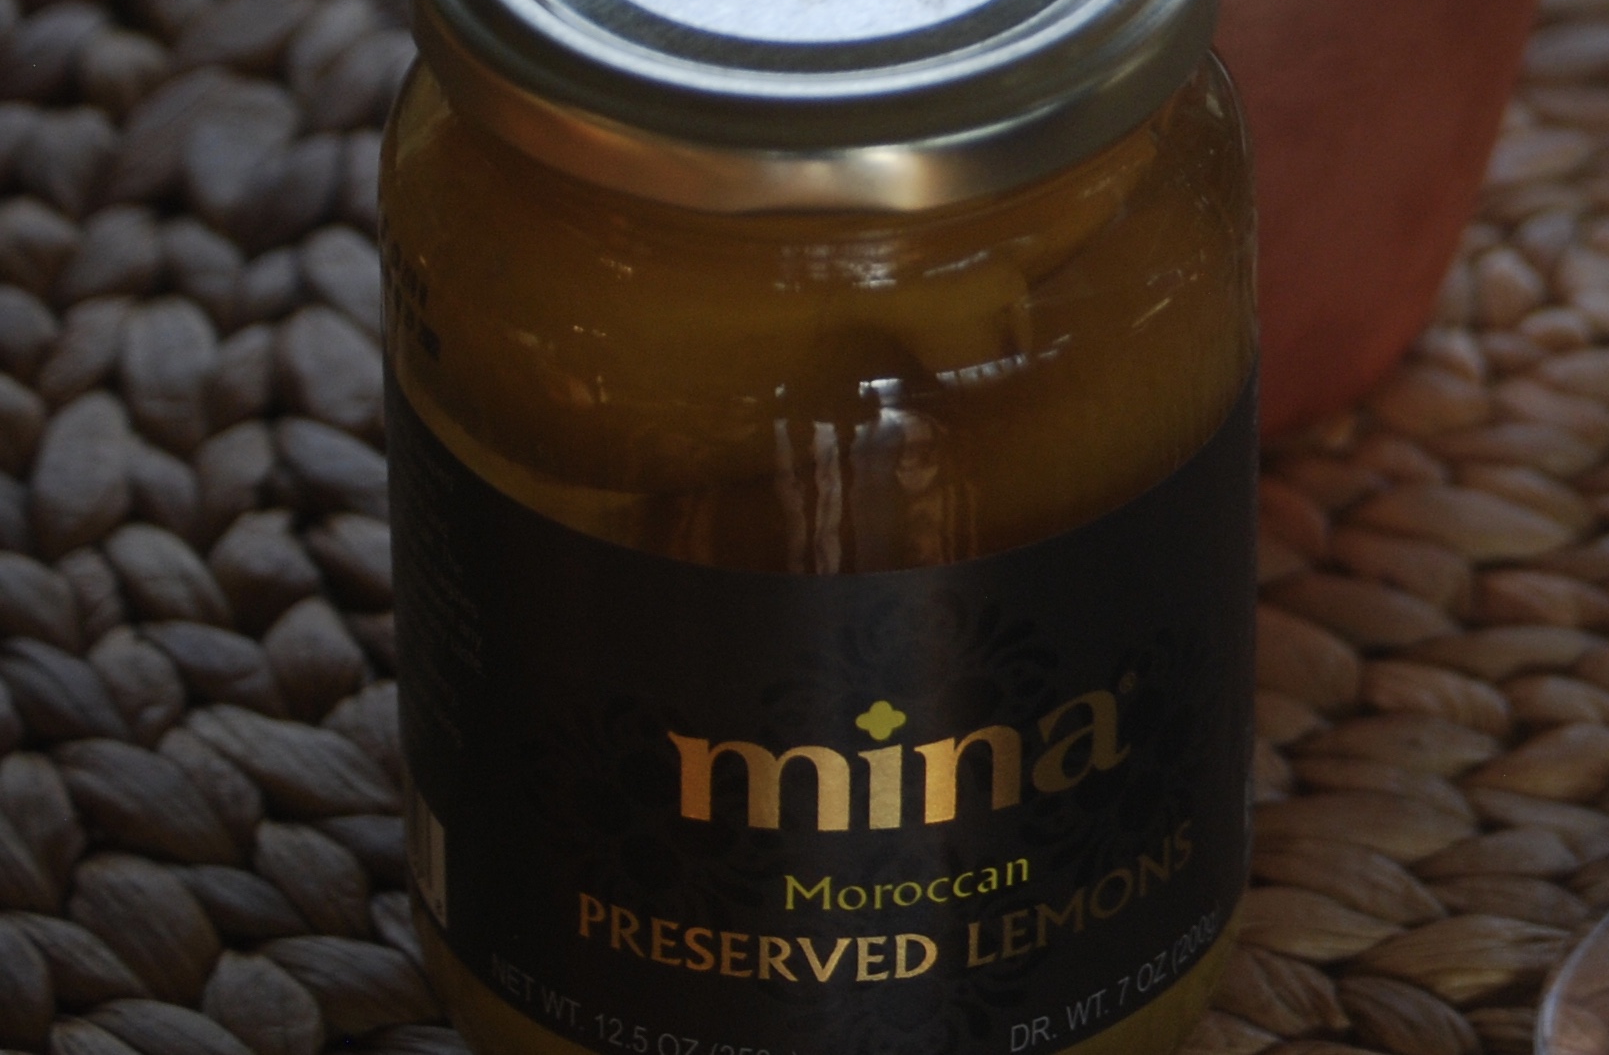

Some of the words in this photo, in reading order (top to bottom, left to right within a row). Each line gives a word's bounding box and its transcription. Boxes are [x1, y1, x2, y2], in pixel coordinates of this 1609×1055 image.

[577, 891, 938, 983] PRESERVED
[966, 818, 1194, 968] LEMONS
[783, 856, 1031, 911] Moroccan
[491, 952, 535, 1002] NET
[541, 986, 586, 1032] WT.
[594, 1012, 650, 1054] 12.5
[1010, 1015, 1058, 1053] DR.
[1065, 988, 1110, 1032] WT.
[1116, 975, 1131, 1007] 7
[1136, 950, 1168, 994] OZ
